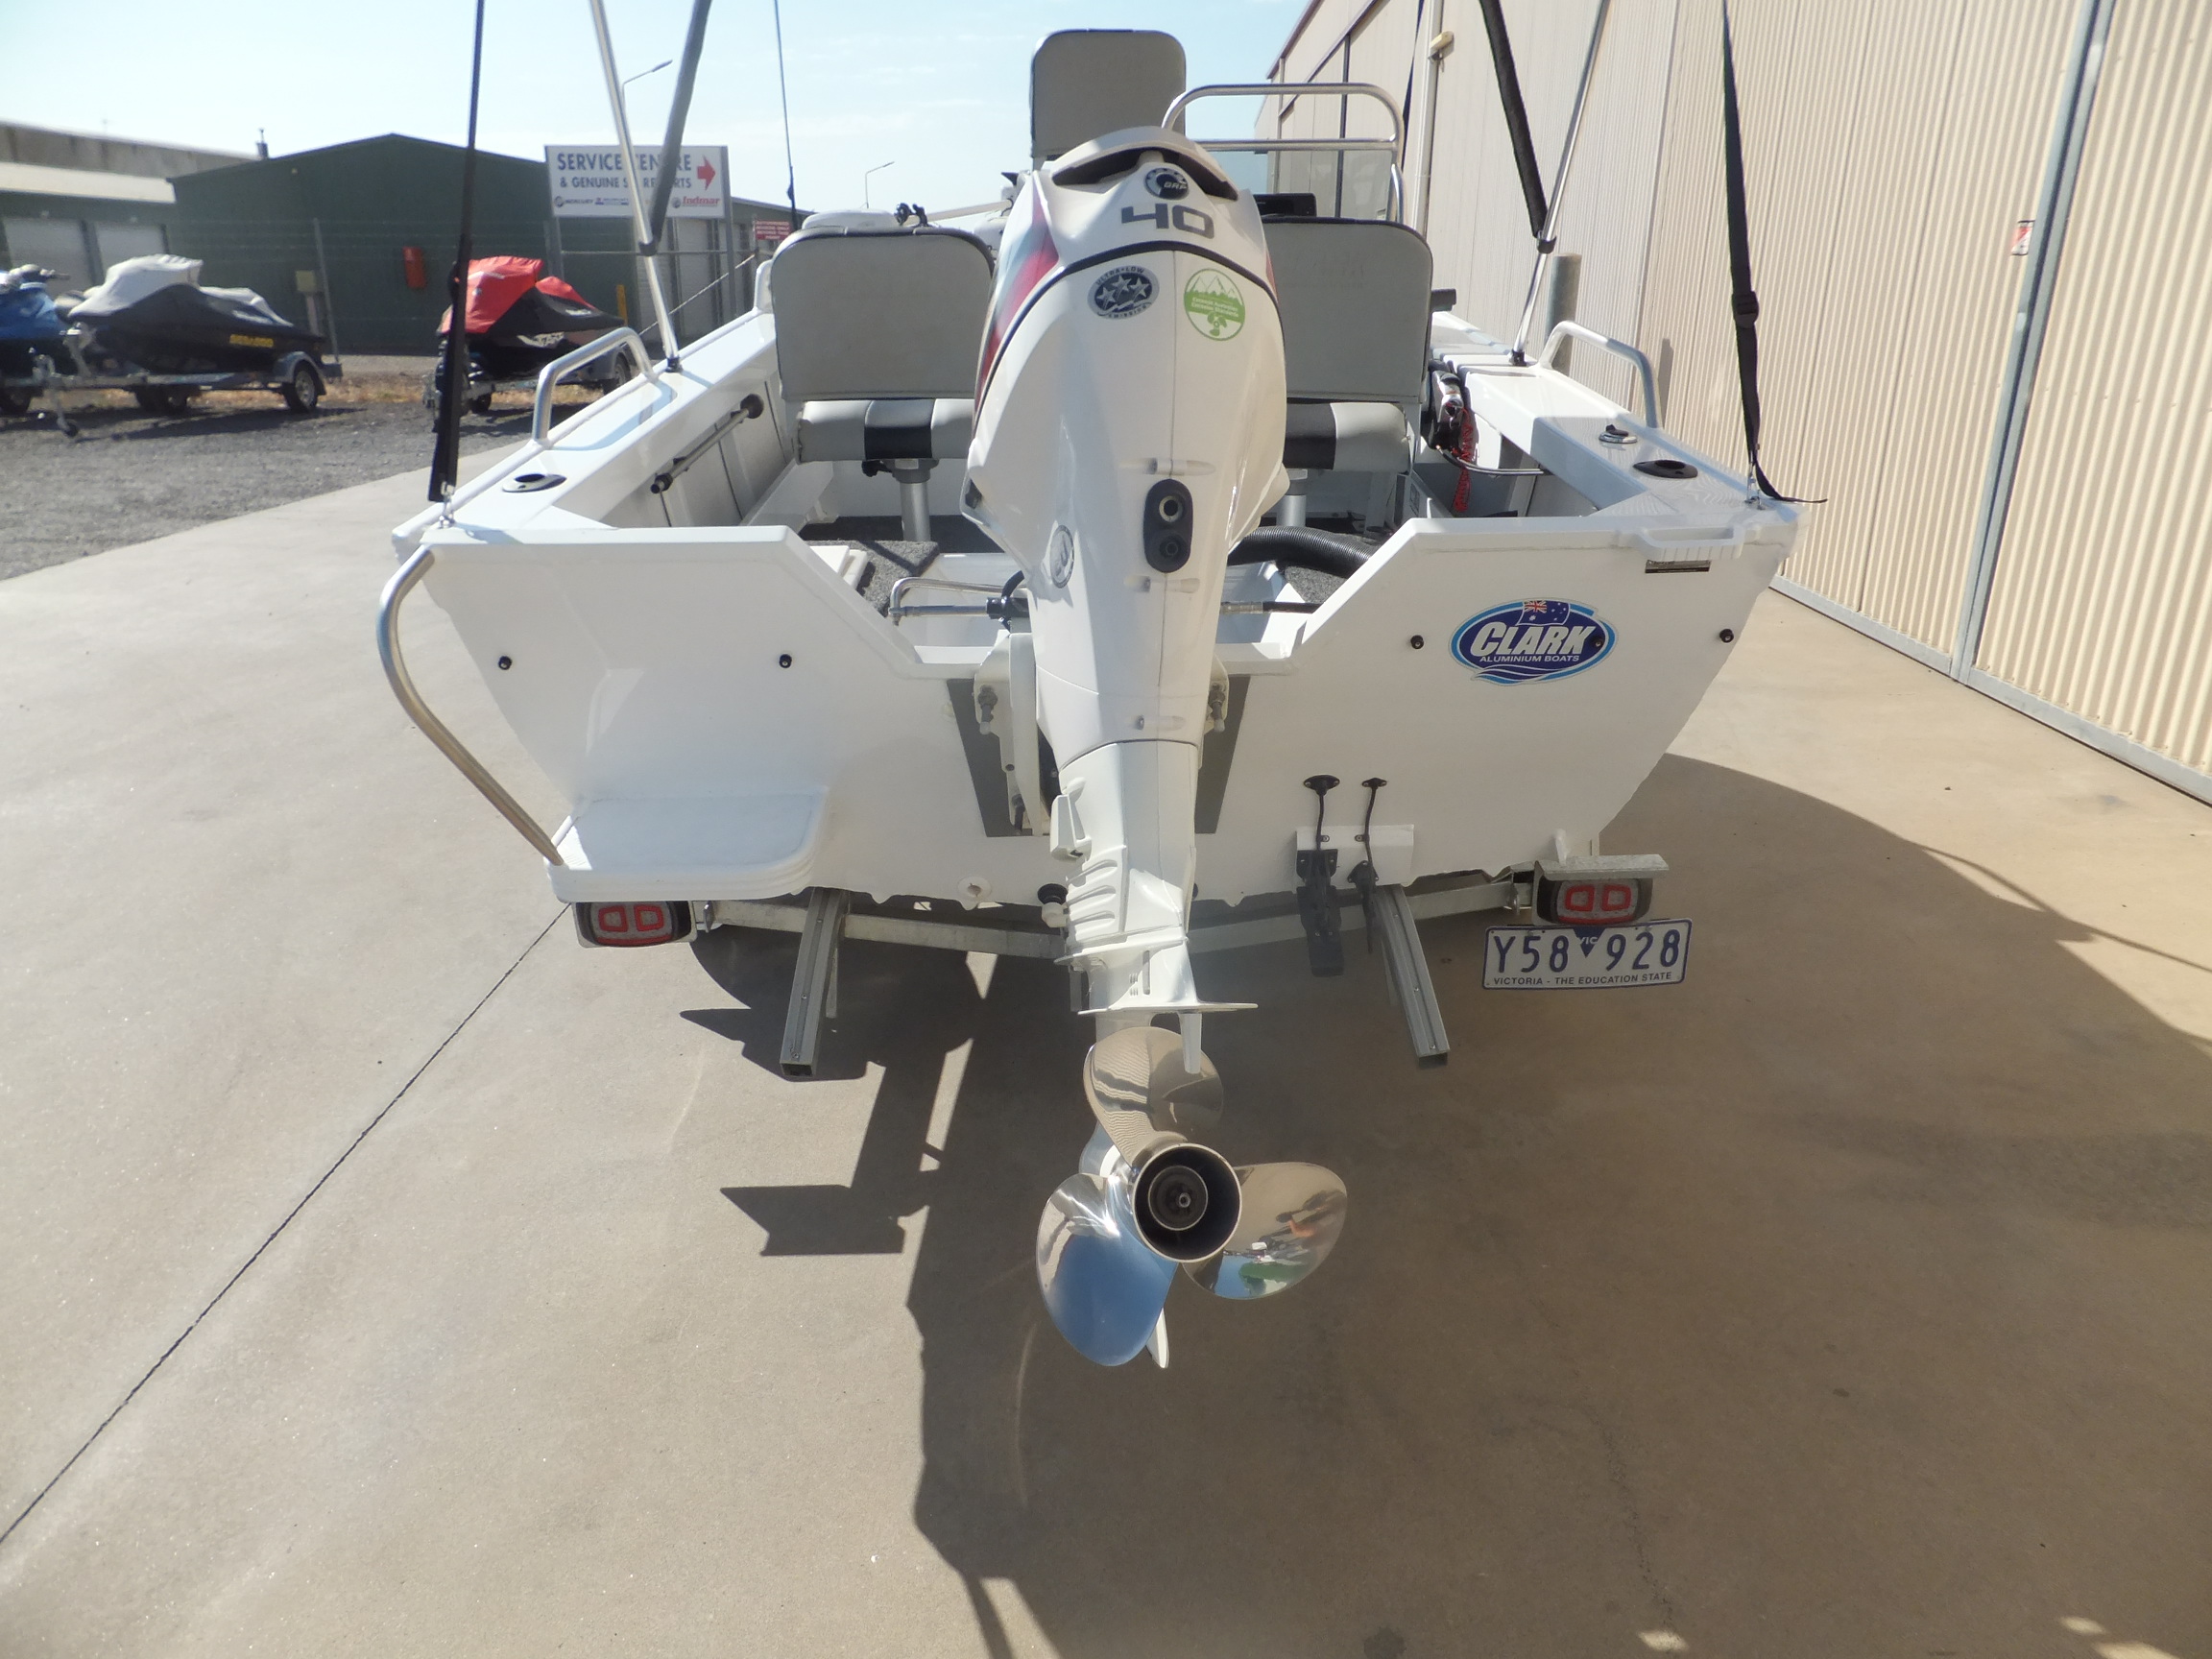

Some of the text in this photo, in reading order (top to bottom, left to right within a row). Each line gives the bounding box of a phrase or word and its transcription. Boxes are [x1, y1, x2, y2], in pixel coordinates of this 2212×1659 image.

[558, 153, 623, 171] SERVICE
[560, 177, 567, 188] &
[571, 177, 620, 188] GENUINE
[1120, 203, 1214, 239] 40
[1470, 621, 1596, 657] CLARK
[1579, 936, 1599, 946] VIC
[1493, 928, 1681, 974] Y58 928
[1493, 977, 1543, 986] VICTORIA
[1555, 976, 1575, 985] THE
[1577, 974, 1639, 985] EDUCATION
[1642, 972, 1672, 981] STATE
